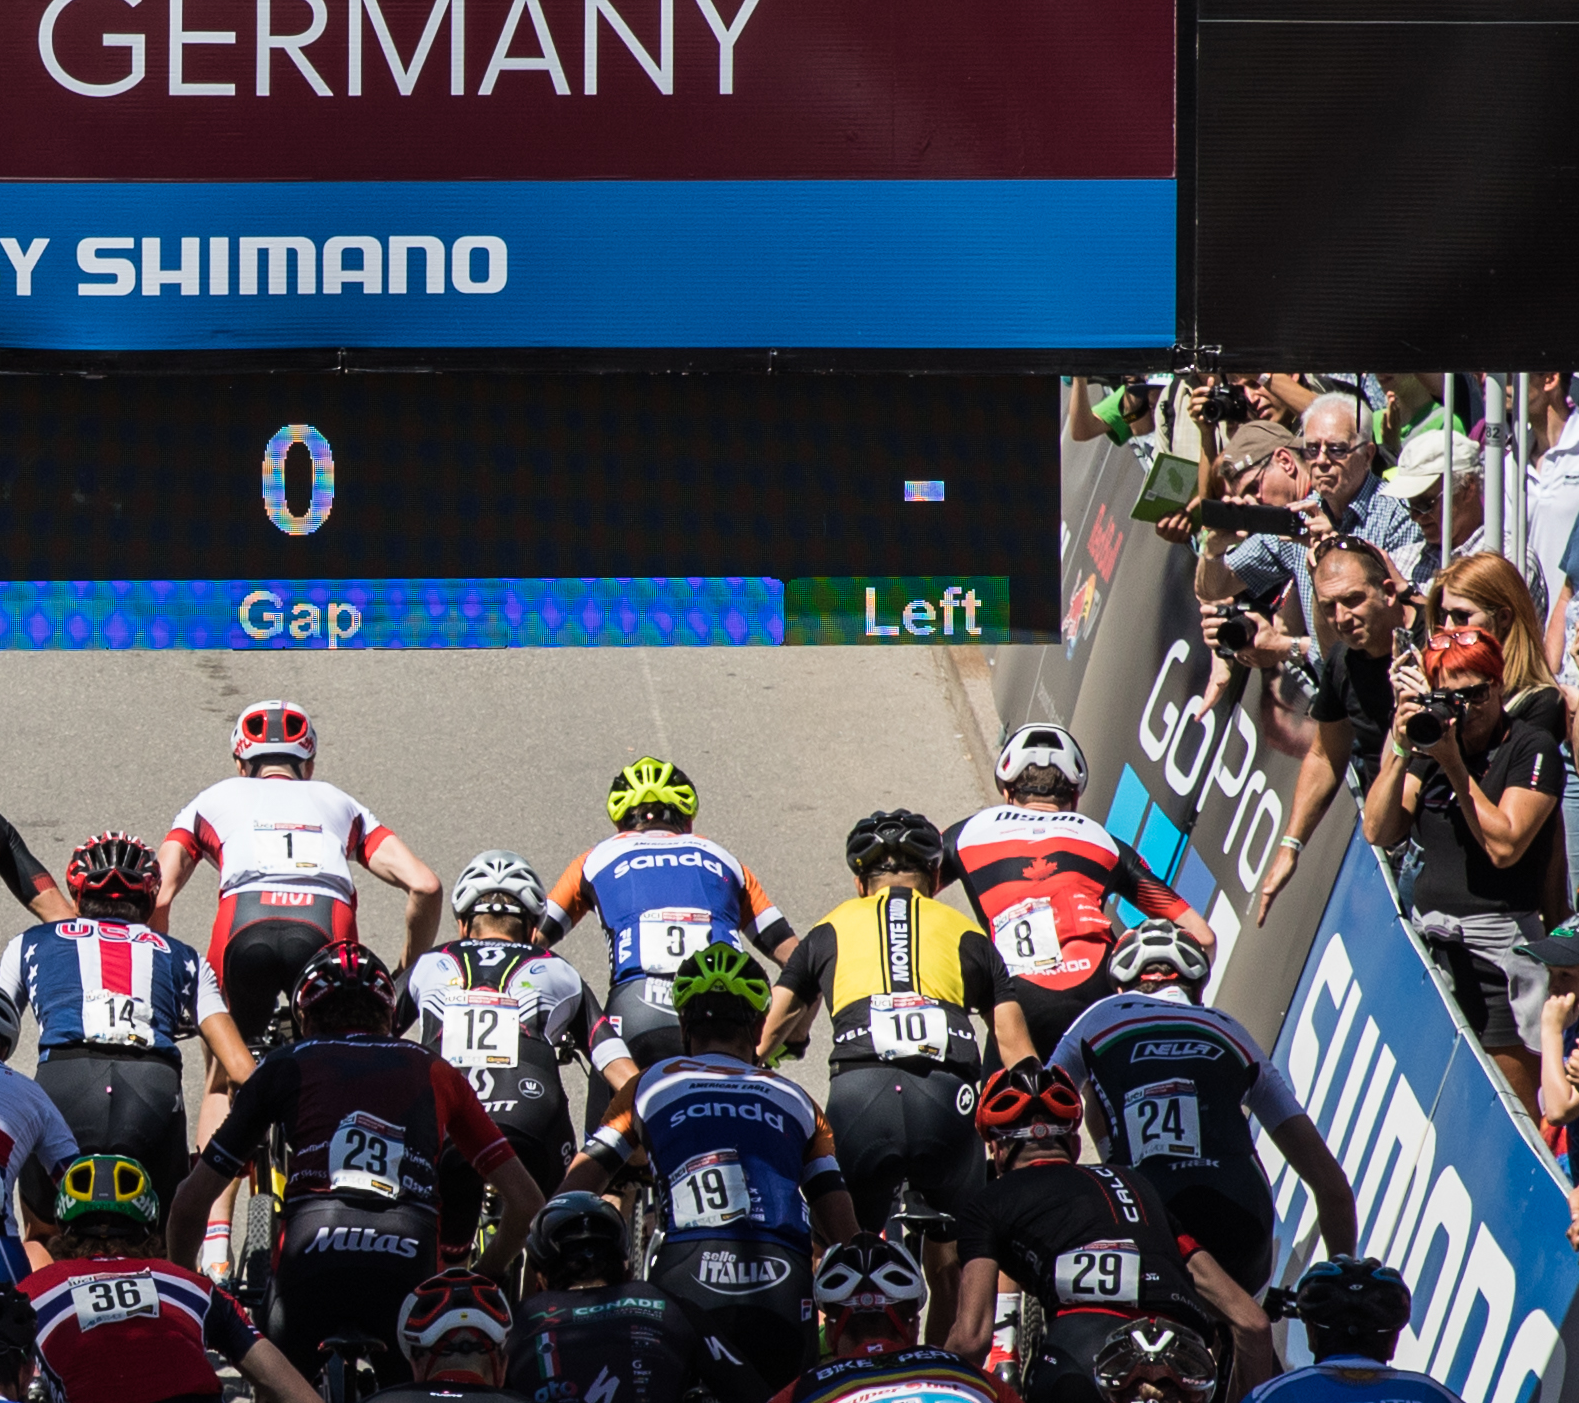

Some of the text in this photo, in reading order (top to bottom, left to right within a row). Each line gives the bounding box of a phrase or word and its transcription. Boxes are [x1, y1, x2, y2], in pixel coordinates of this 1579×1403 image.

[76, 234, 510, 297] SHIMANO
[262, 424, 334, 535] 0
[238, 591, 361, 639] Gap
[865, 586, 982, 638] Left
[1138, 640, 1284, 895] GoPro
[283, 833, 294, 859] 1
[614, 849, 724, 878] sandd
[56, 921, 171, 953] USA
[667, 926, 686, 955] 3
[1013, 921, 1035, 959] 8
[465, 1010, 499, 1052] 12
[889, 1012, 927, 1042] 10
[1143, 1041, 1211, 1059] NELLA
[1142, 1102, 1185, 1141] 24
[344, 1134, 387, 1171] 23
[304, 1226, 419, 1259] Mitas
